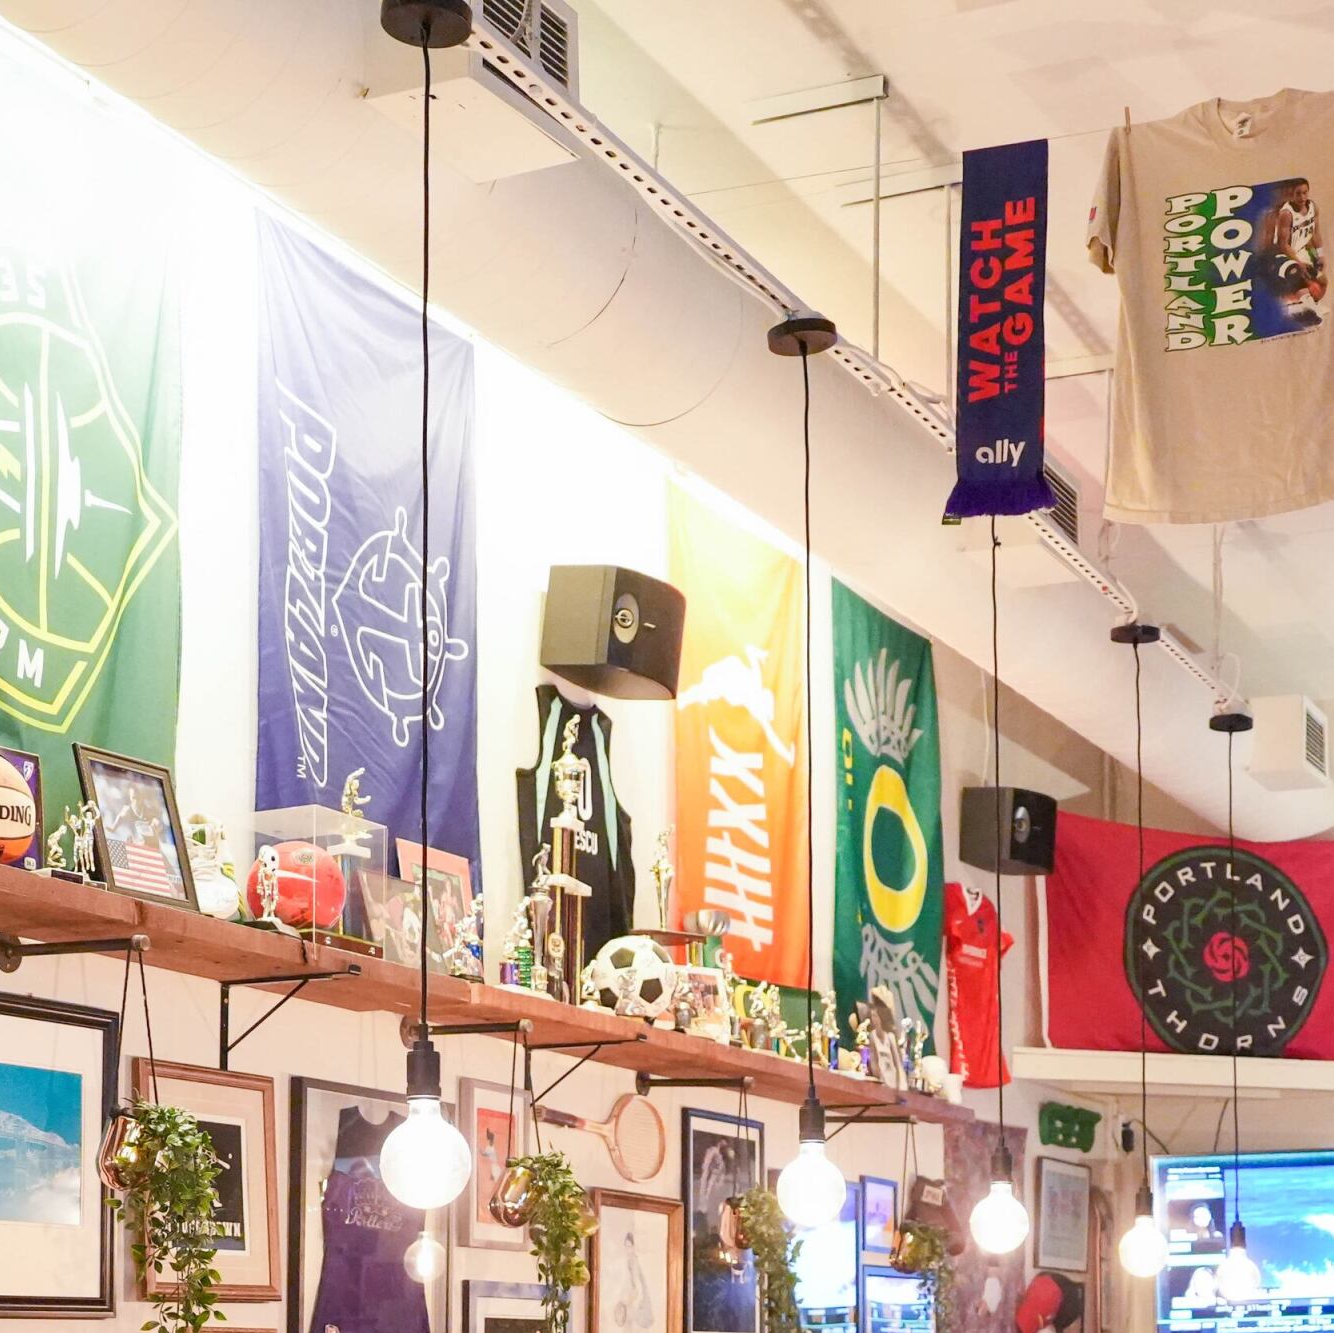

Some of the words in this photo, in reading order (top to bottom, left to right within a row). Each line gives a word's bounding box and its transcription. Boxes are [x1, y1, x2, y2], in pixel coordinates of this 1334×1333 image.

[968, 218, 1003, 403] WATCH
[1002, 197, 1035, 346] GAME
[1164, 192, 1208, 351] PORTLAND
[1209, 185, 1254, 346] POWER
[1004, 351, 1018, 394] THE
[975, 438, 1026, 467] ally
[1142, 861, 1305, 935] PORTLAND
[1147, 979, 1309, 1050] THORNS
